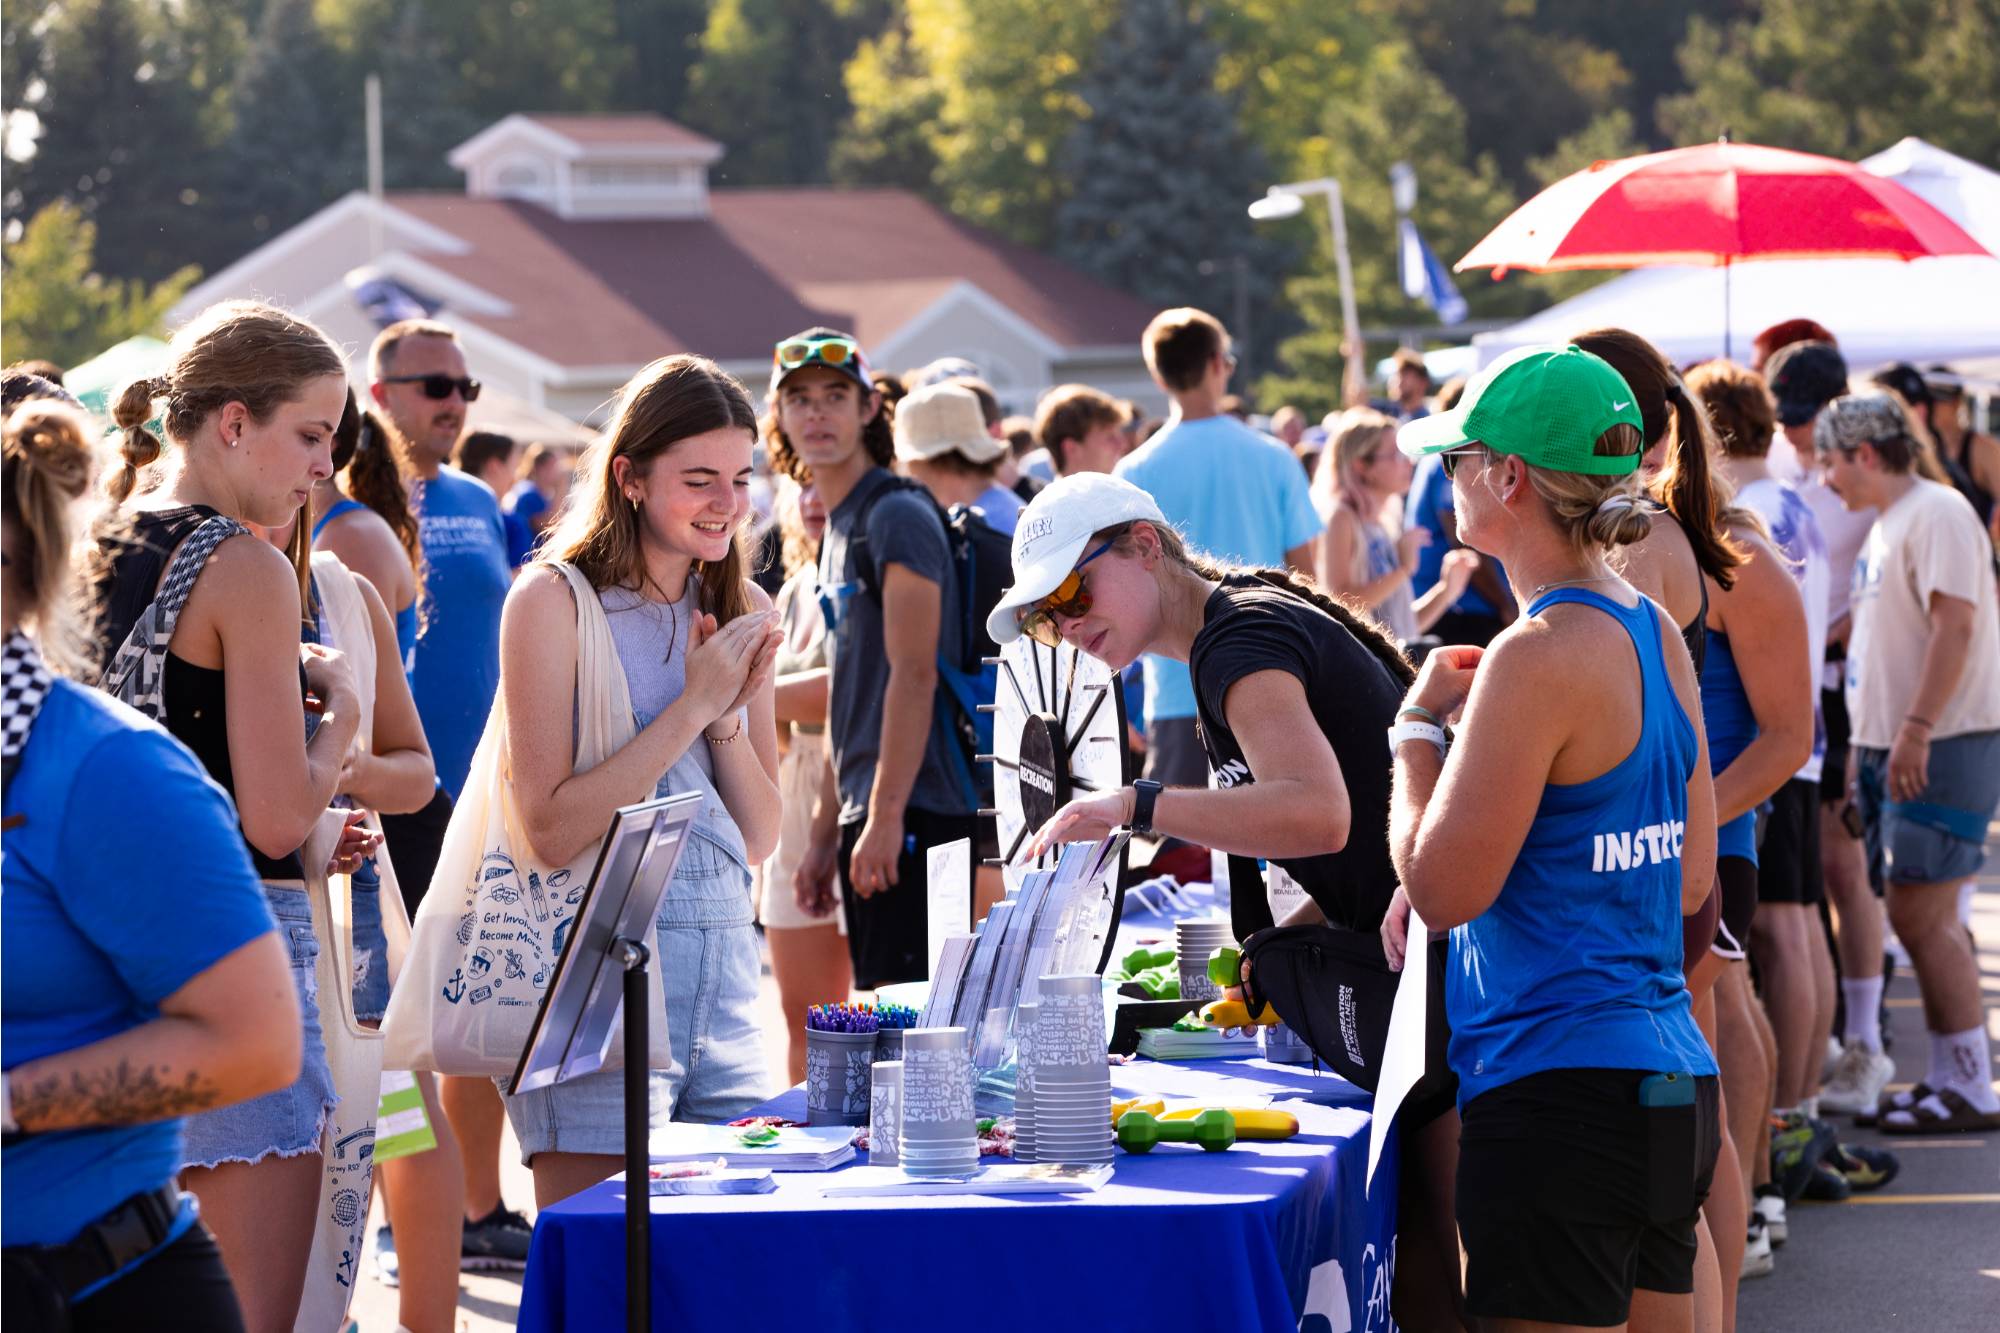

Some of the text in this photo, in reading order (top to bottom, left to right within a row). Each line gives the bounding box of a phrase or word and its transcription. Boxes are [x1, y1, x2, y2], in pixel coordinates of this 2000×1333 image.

[1019, 764, 1054, 796] RECREATION
[1273, 888, 1303, 896] STANLEY
[483, 912, 542, 940] Get Involved.
[480, 930, 543, 954] Become More.
[1338, 984, 1351, 1052] RECREATION
[1344, 986, 1354, 1044] WELLNESS
[1067, 1016, 1085, 1025] live
[1066, 1031, 1080, 1039] be
[1071, 1042, 1088, 1052] get
[928, 1072, 946, 1082] live
[927, 1087, 940, 1095] be
[931, 1098, 949, 1108] get
[336, 1166, 346, 1174] my
